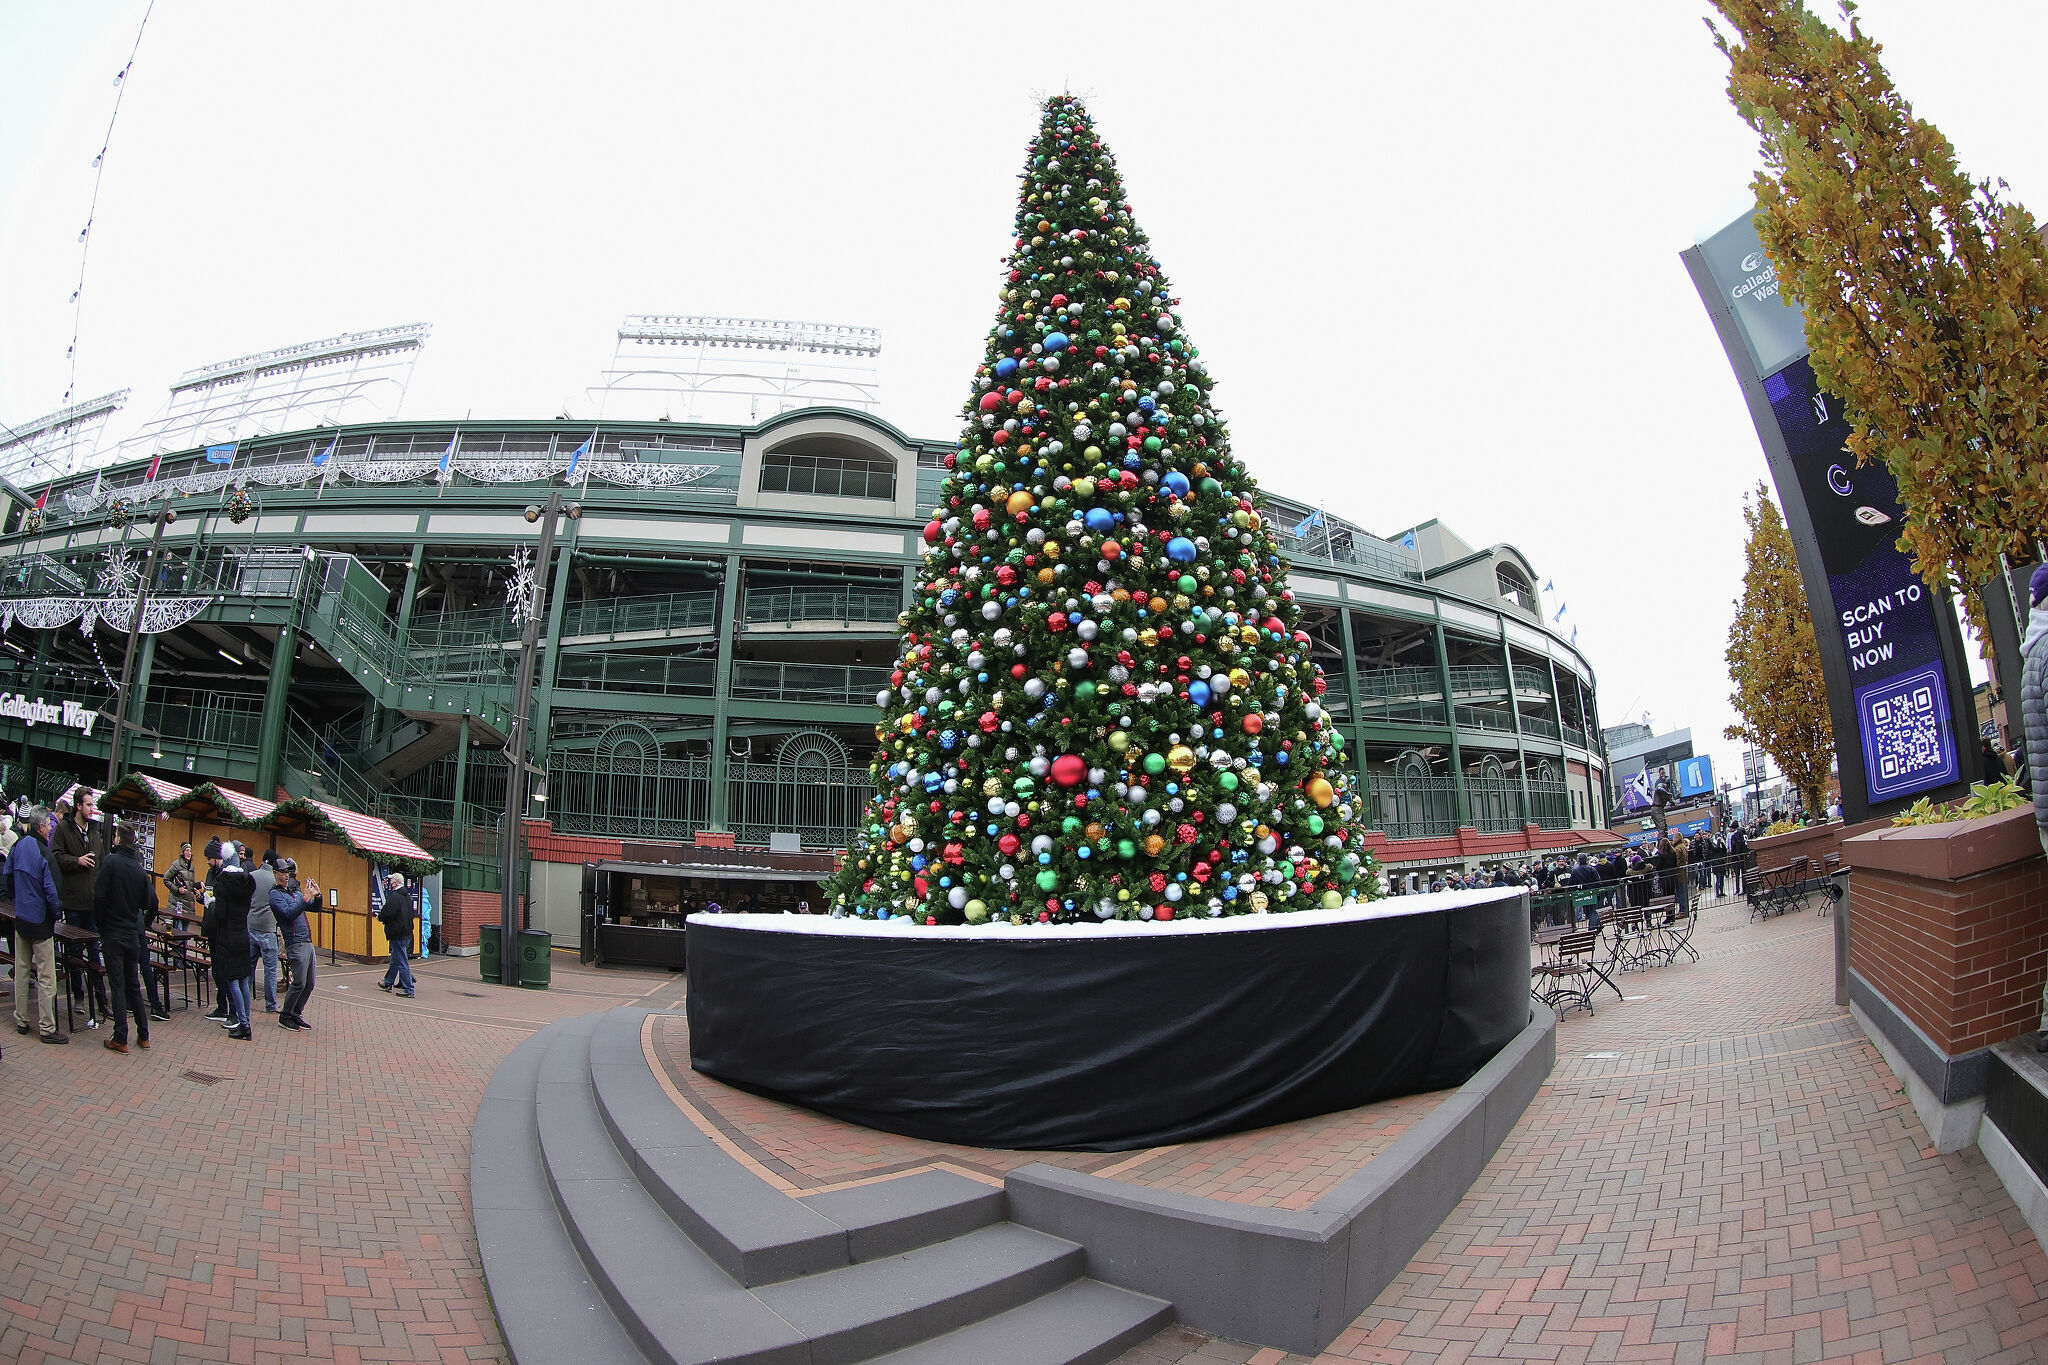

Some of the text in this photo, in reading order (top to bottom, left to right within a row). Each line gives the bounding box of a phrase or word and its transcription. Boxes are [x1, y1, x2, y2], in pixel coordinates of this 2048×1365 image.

[1841, 584, 1921, 627] SCAN TO
[1847, 622, 1884, 650] BUY
[1851, 642, 1895, 672] NOW
[0, 692, 99, 736] Gallagher Way
[1403, 856, 1458, 868] TICKETS
